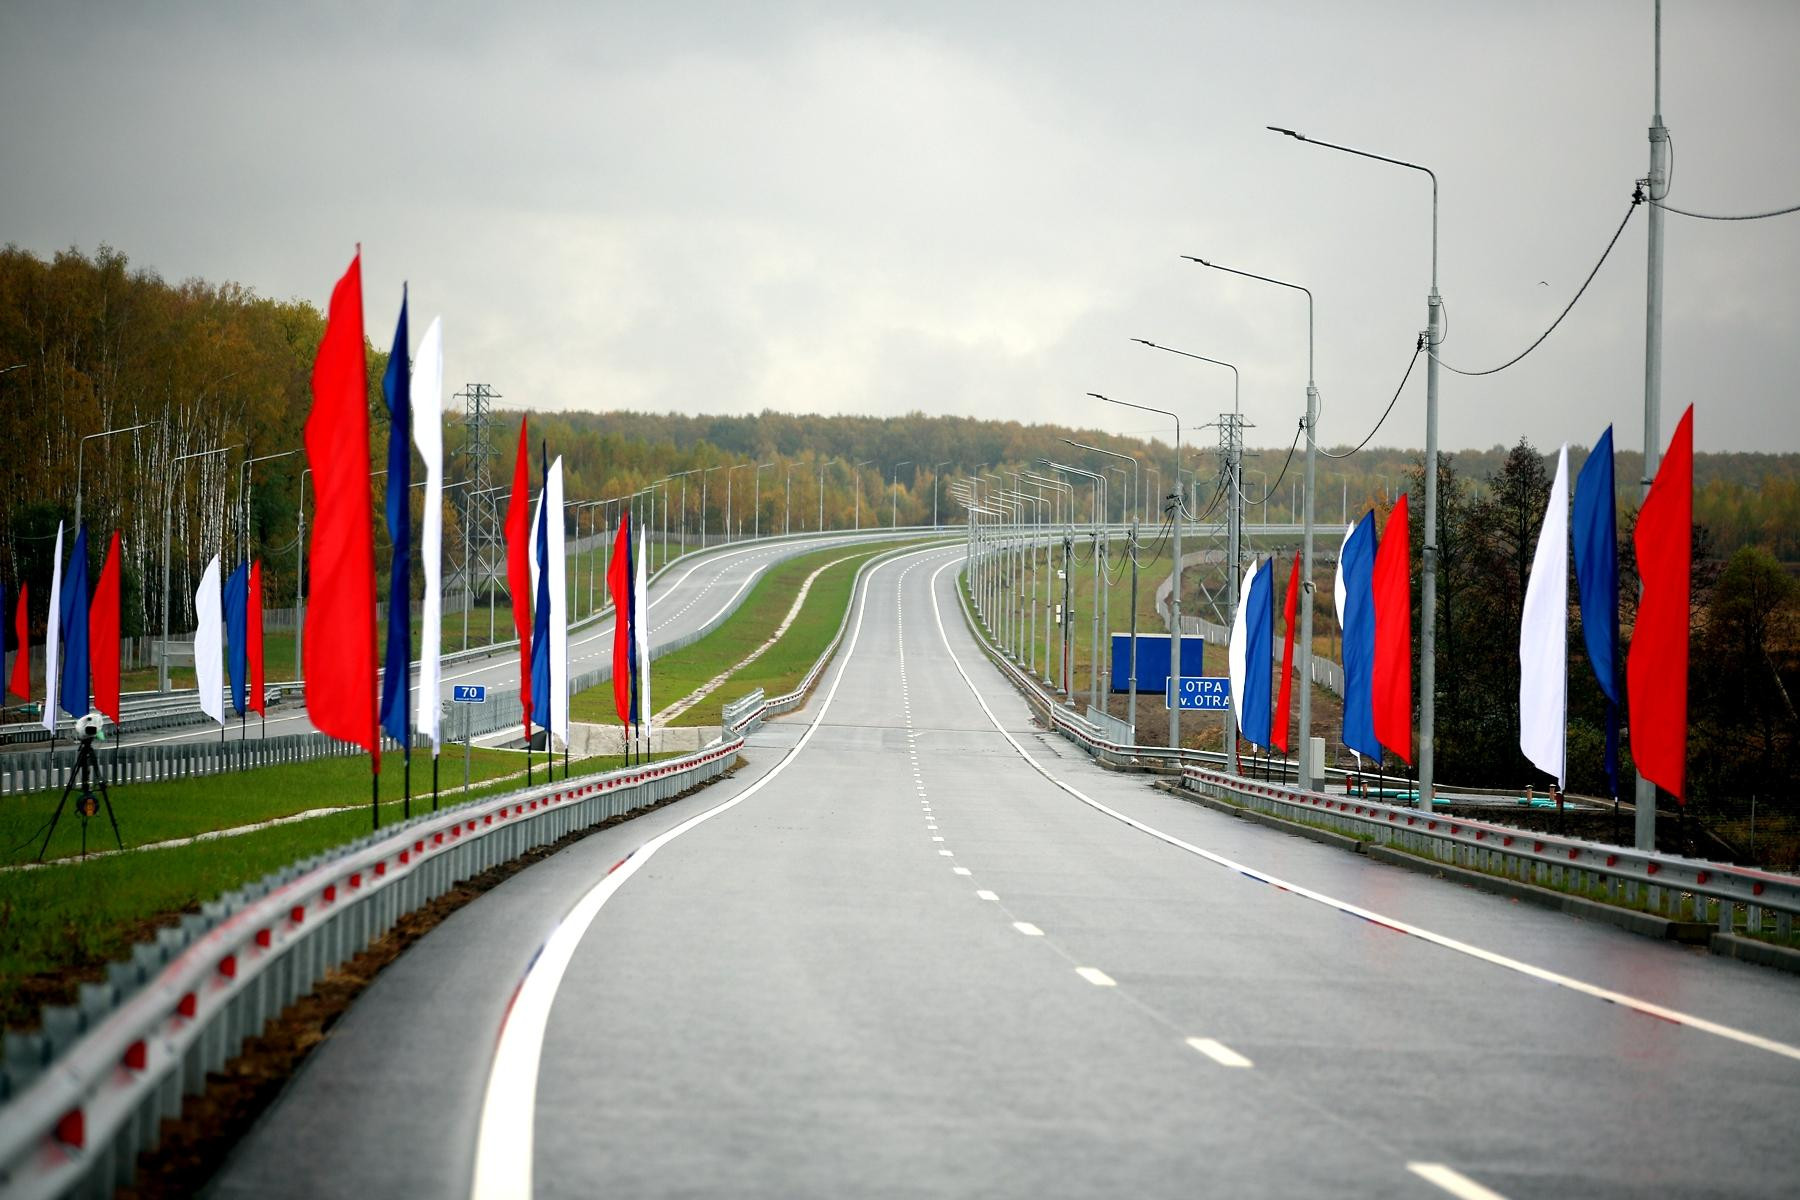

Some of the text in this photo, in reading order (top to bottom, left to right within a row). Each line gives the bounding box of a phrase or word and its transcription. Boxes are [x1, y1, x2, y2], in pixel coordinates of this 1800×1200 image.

[461, 687, 477, 698] 70
[1185, 681, 1223, 693] ОТРА
[1194, 694, 1230, 706] OTRA
